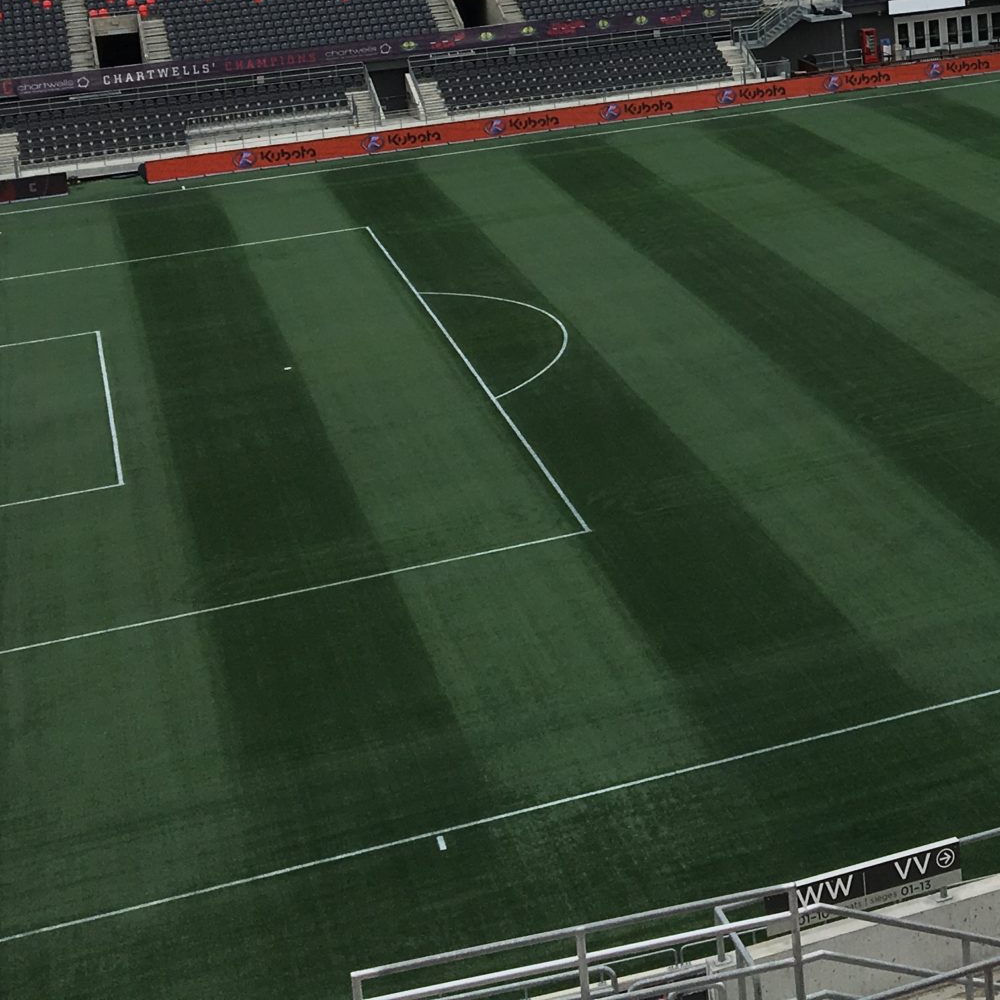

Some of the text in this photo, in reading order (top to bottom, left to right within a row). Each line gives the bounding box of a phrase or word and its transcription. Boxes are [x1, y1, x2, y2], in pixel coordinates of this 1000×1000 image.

[103, 52, 317, 86] CHARTWELLS' CHAMPIONS
[946, 59, 990, 73] Kubota
[845, 71, 891, 86] Kubota
[739, 85, 786, 99] Kubota
[624, 100, 673, 115] Kubota
[509, 115, 560, 130] Kubota
[388, 131, 441, 146] Kubota
[260, 146, 317, 163] Kubota
[796, 852, 931, 910] WW VV
[900, 880, 931, 896] 01-13
